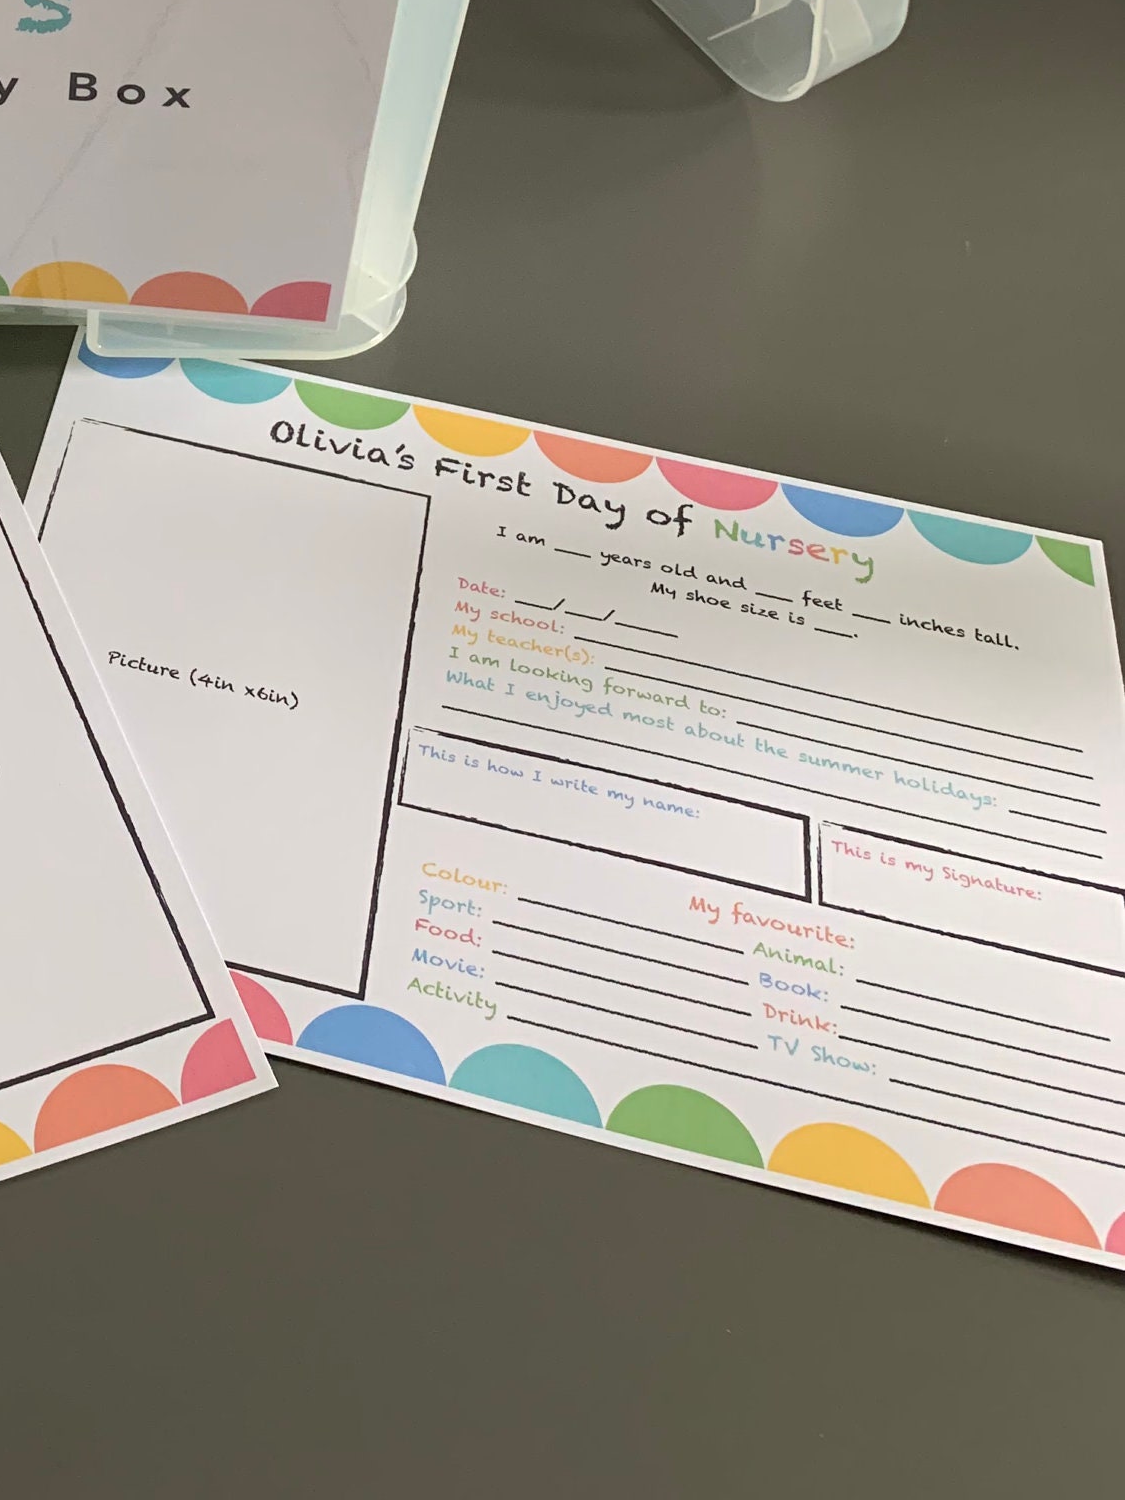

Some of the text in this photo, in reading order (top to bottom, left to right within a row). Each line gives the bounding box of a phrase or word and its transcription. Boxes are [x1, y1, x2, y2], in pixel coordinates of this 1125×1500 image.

[68, 71, 192, 109] Box
[269, 420, 874, 590] Olivia's First Day of Nursery
[458, 577, 505, 598] Date:
[496, 526, 1019, 651] I am years old and feet inches tall.
[650, 582, 805, 625] My shoe size is
[454, 601, 564, 634] My school:
[452, 625, 595, 665] My teacher(s):
[108, 651, 180, 680] Picture
[449, 646, 726, 718] I am looking forward to:
[447, 670, 997, 810] What I enjoyed most about the summer holidays:
[419, 744, 699, 818] This is how I write my name:
[422, 863, 507, 894] Colour:
[831, 840, 1042, 900] This is my Signature:
[419, 889, 482, 917] Sport:
[689, 896, 854, 949] My favourite:
[415, 918, 482, 947] Food:
[411, 948, 485, 978] Movie:
[753, 942, 844, 976] Animal:
[407, 975, 497, 1021] Activity
[760, 972, 828, 1002] Book:
[763, 1003, 837, 1035] Drink:
[767, 1035, 876, 1075] TV Show:
